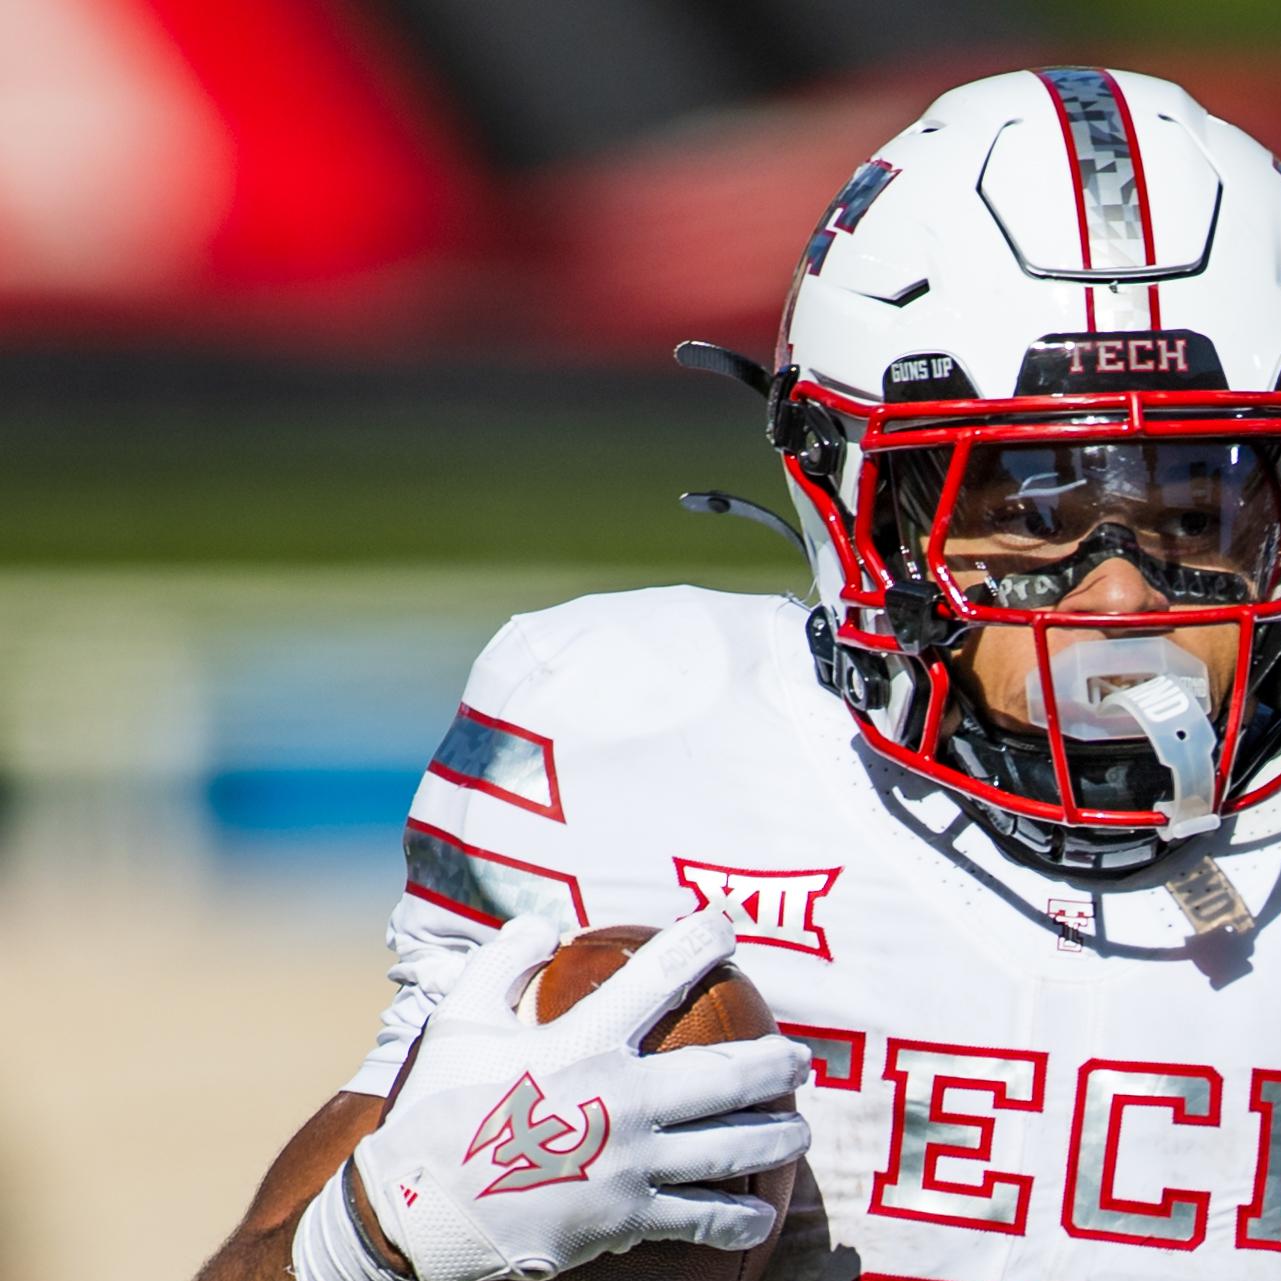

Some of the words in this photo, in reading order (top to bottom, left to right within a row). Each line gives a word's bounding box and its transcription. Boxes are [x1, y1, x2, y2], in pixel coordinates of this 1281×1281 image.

[890, 360, 929, 383] GUNS
[931, 357, 953, 379] UP
[1066, 339, 1188, 374] TECH
